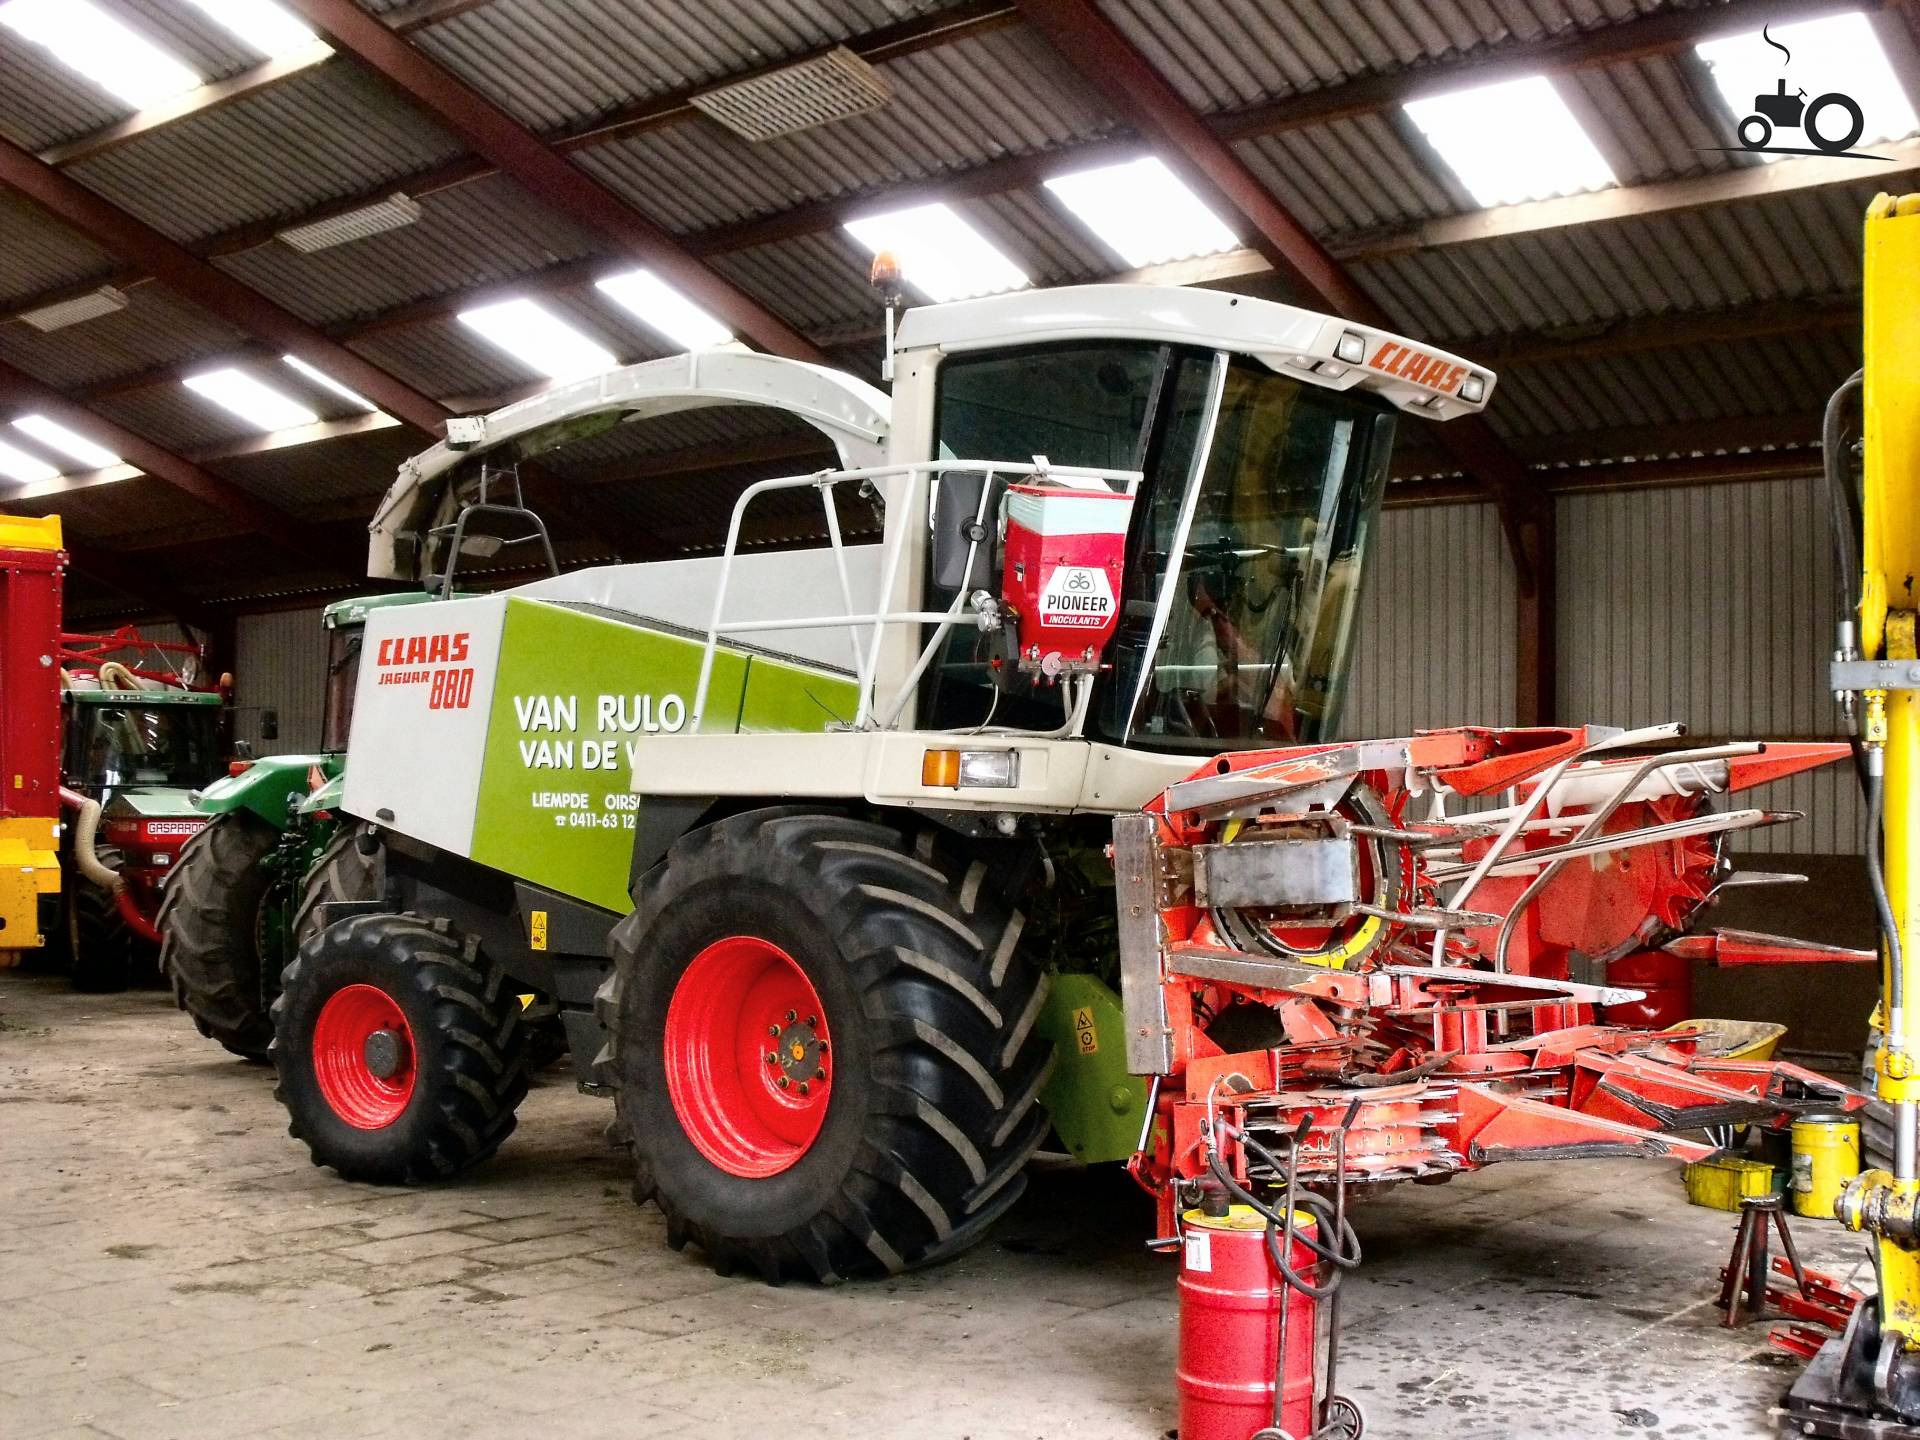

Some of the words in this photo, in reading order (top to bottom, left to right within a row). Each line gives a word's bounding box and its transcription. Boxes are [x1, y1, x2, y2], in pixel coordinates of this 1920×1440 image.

[1368, 341, 1467, 393] CLAAS
[1047, 594, 1108, 612] PIONEER
[1049, 615, 1100, 626] INOCULANTS
[376, 632, 470, 666] CLAAS
[378, 670, 431, 685] JAGUAR
[429, 668, 474, 710] 880
[513, 695, 577, 733] VAN
[597, 694, 687, 734] RULO
[519, 740, 574, 770] VAN
[582, 740, 619, 771] DE
[532, 792, 589, 809] LIEMPDE
[569, 812, 618, 829] 0411-63
